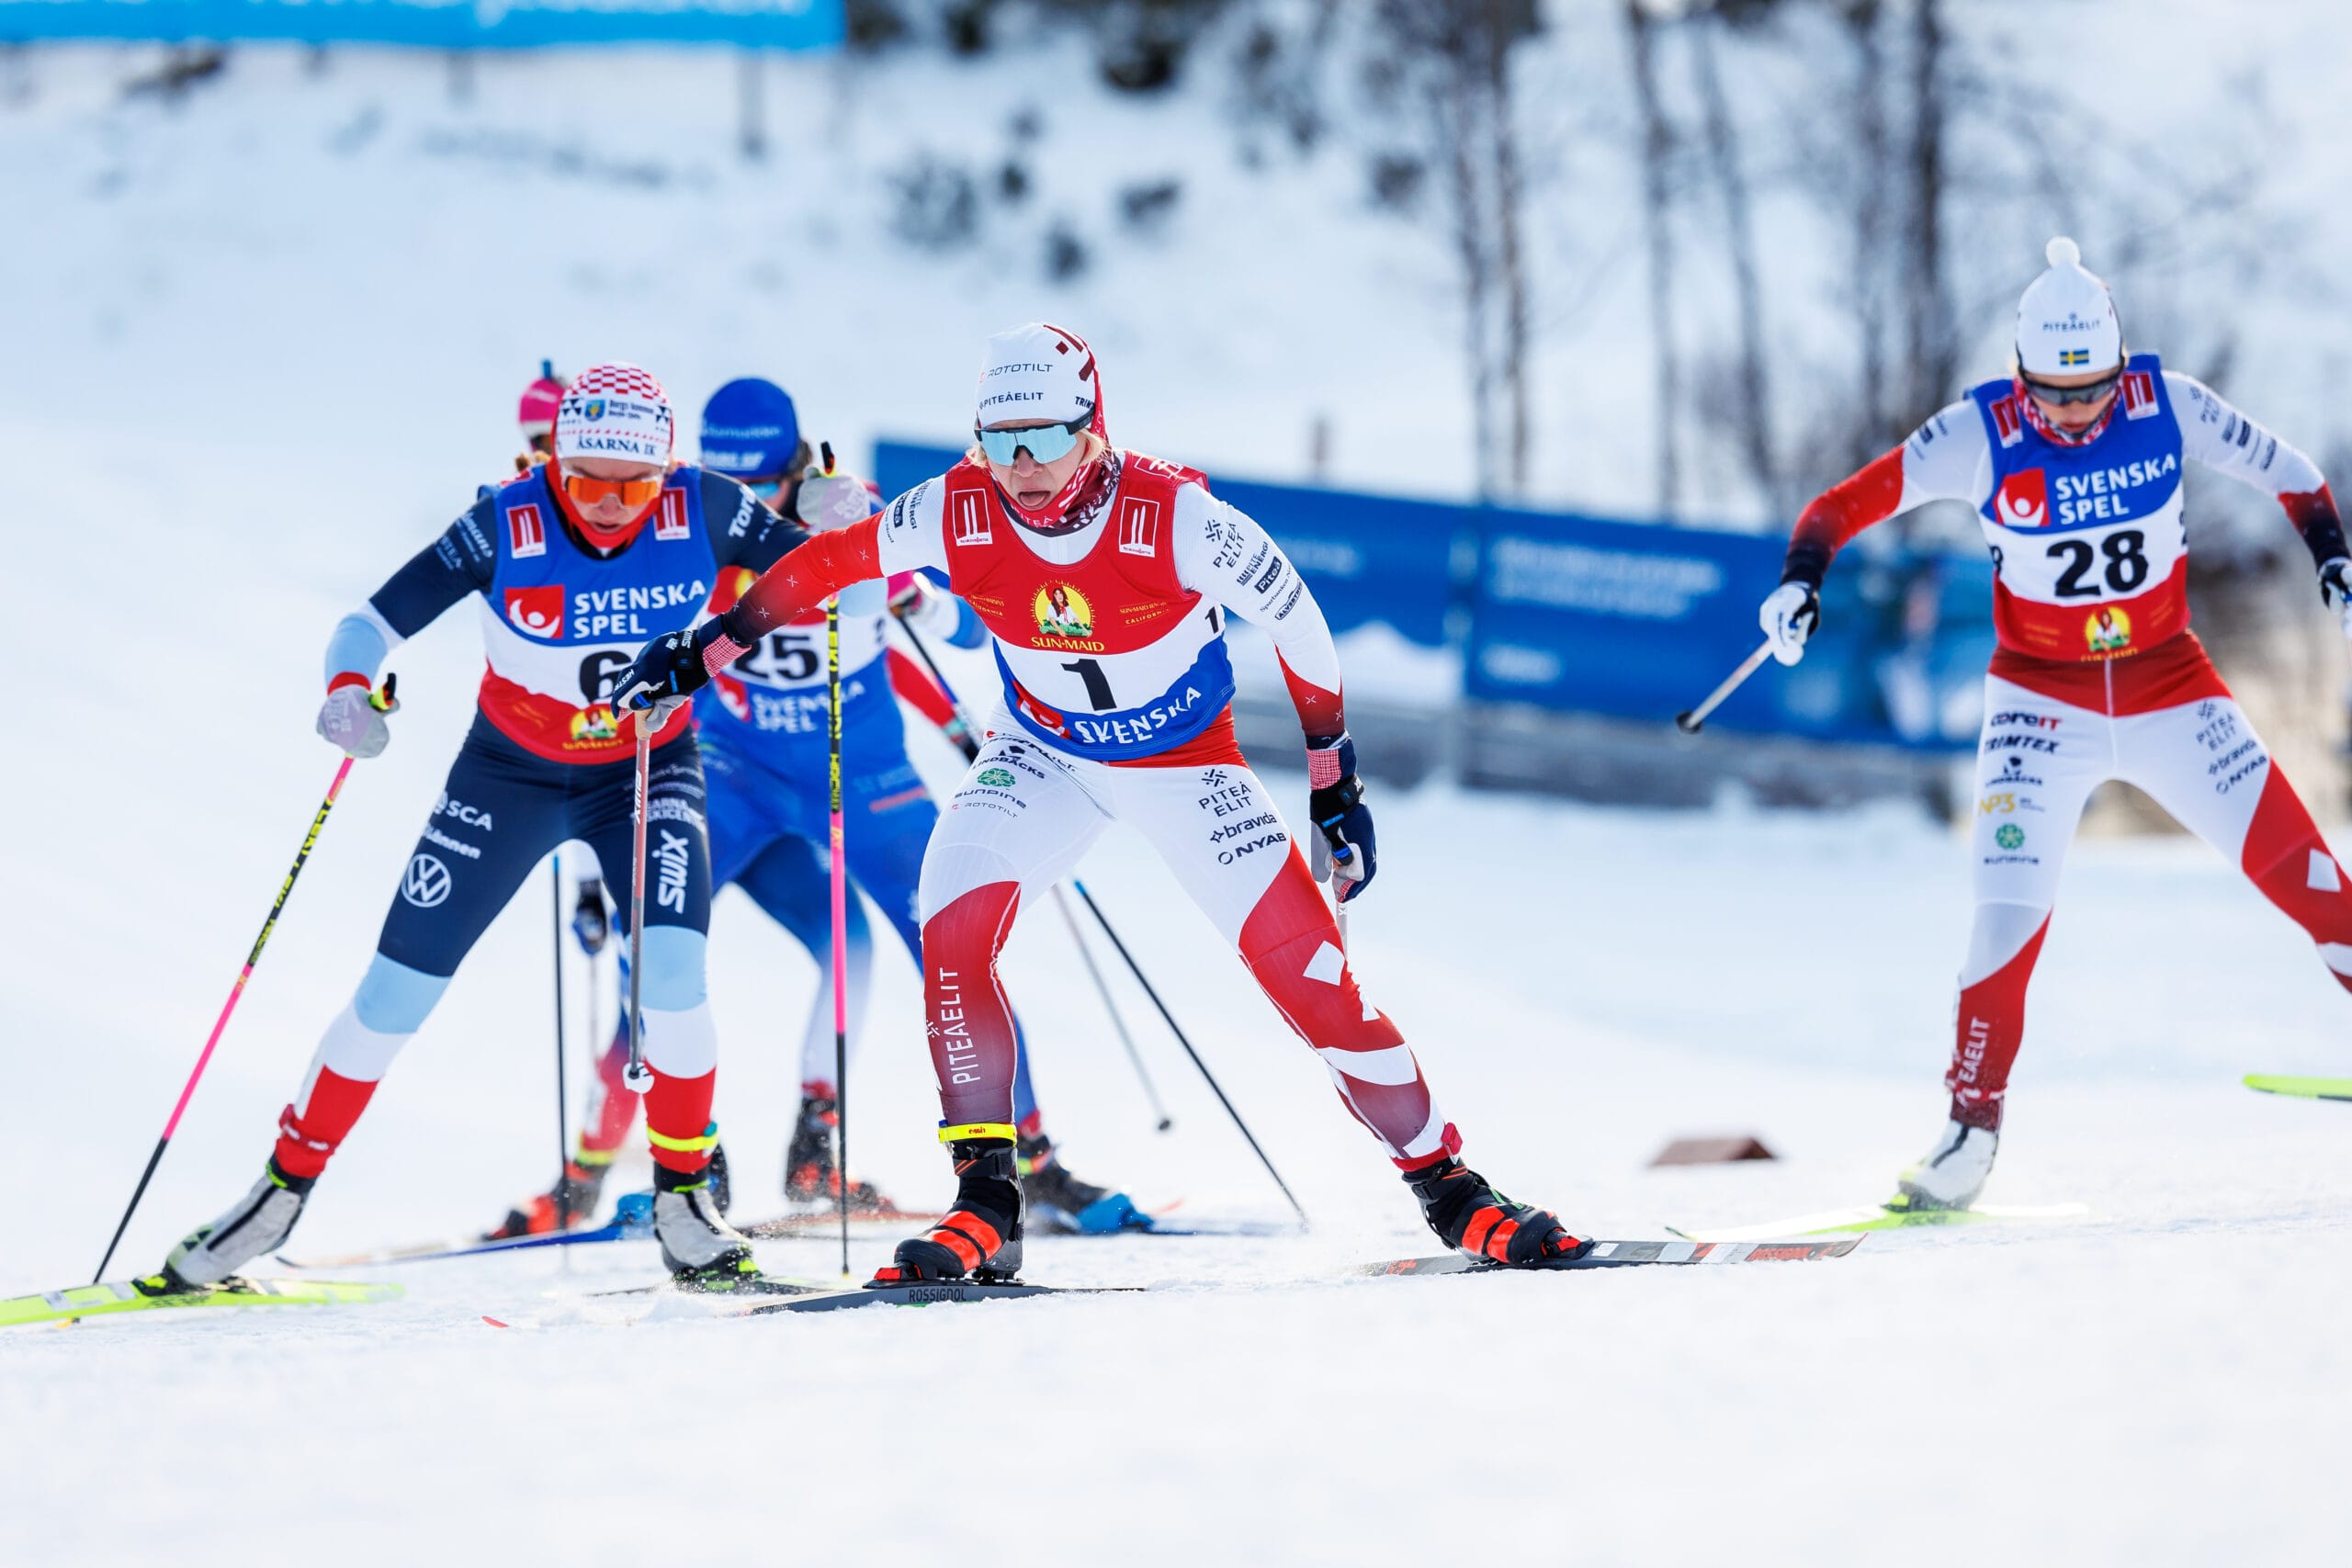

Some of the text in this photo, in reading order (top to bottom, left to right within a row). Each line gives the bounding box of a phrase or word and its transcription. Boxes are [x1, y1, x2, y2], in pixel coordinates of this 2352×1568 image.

[988, 363, 1054, 378] ROTOTILT
[2055, 454, 2177, 501] SVENSKA
[2058, 493, 2130, 525] SPEL
[1213, 521, 1237, 568] PITEÅ
[1227, 533, 1245, 568] ELIT
[1250, 541, 1269, 575] ENERGI
[2047, 530, 2149, 597] 28
[573, 580, 707, 615] SVENSKA
[573, 614, 647, 639] SPEL
[1204, 606, 1219, 634] 1
[580, 650, 632, 707] 6
[1061, 659, 1117, 711] 1
[1198, 781, 1252, 810] PITEÅ
[1213, 795, 1252, 818] ELIT
[446, 799, 492, 831] SCA
[1223, 811, 1278, 839] bravida
[1235, 832, 1287, 858] NYAB
[909, 1289, 967, 1303] ROSSIGNOL
